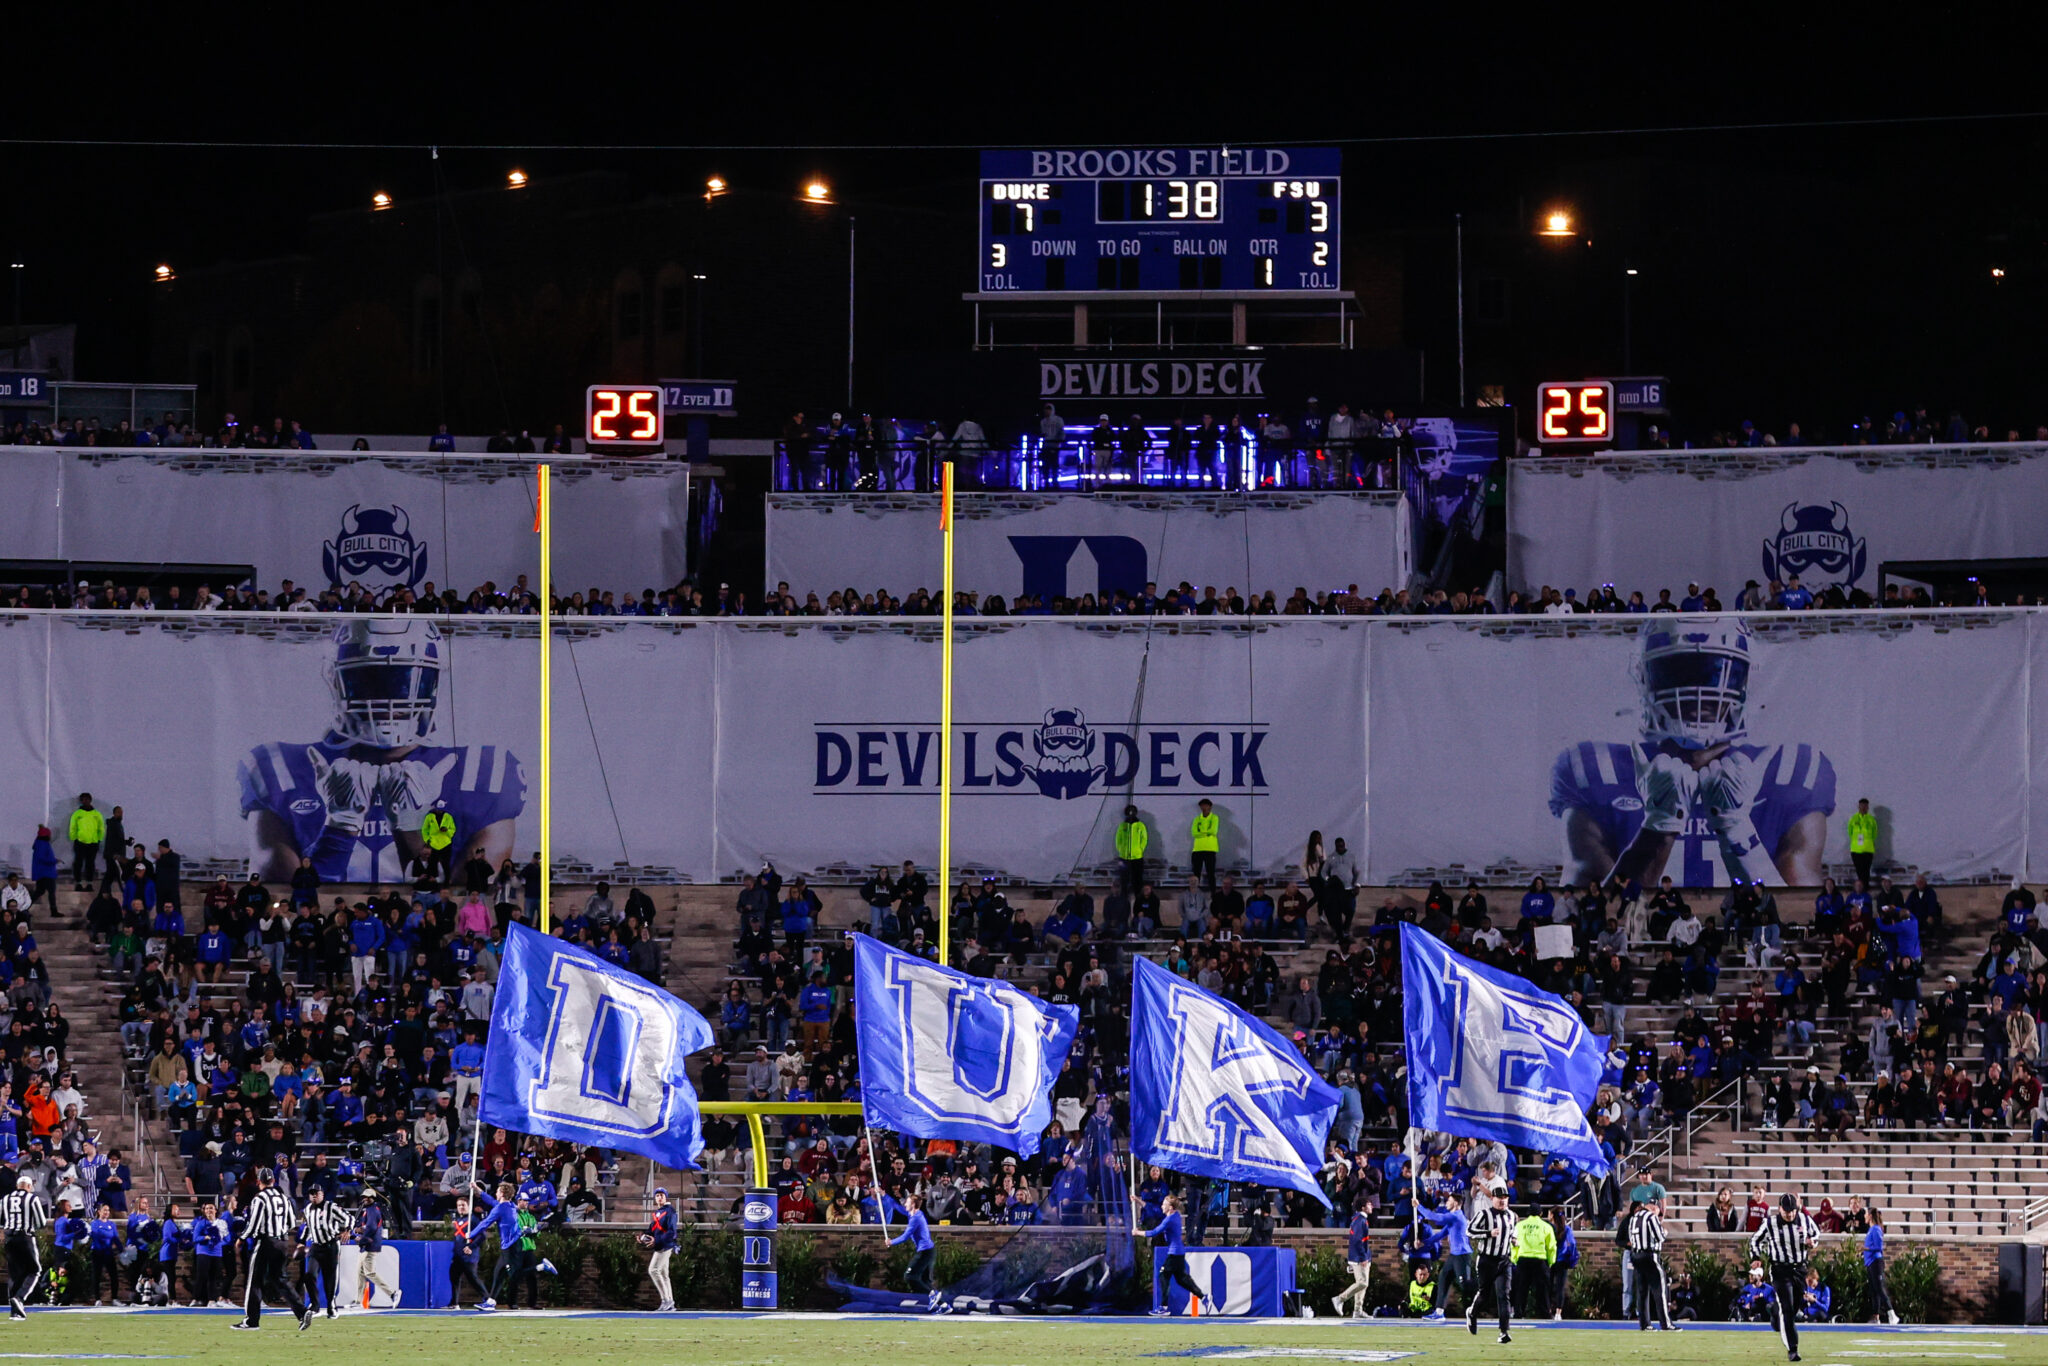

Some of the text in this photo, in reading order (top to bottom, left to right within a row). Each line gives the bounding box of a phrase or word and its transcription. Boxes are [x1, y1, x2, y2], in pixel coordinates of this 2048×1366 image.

[1031, 149, 1290, 177] BROOKS FIELD
[992, 183, 1050, 200] DUKE
[1144, 180, 1218, 219] 1:38
[1273, 181, 1321, 199] FSU
[1016, 203, 1033, 232] 7
[1310, 201, 1328, 232] 3
[991, 243, 1006, 268] 3
[1031, 240, 1077, 256] DOWN
[1098, 240, 1141, 256] TO GO
[1173, 240, 1228, 256] BALL ON
[1249, 239, 1279, 256] QTR
[1312, 241, 1328, 266] 2
[984, 274, 1020, 290] T.O.L.
[1265, 258, 1273, 286] 1
[1299, 272, 1335, 289] T.O.L.
[20, 377, 38, 396] 18
[1040, 362, 1265, 396] DEVILS DECK
[683, 394, 711, 406] EVEN
[1619, 385, 1660, 405] ODD 16
[593, 391, 656, 438] 25
[1545, 388, 1606, 436] 25
[343, 536, 407, 554] BULL CITY
[1783, 533, 1846, 552] BULL CITY
[1045, 727, 1083, 738] BULL CITY
[1101, 731, 1269, 787] DECK
[358, 820, 393, 837] UK
[529, 951, 678, 1139] D
[885, 953, 1059, 1134] U
[1438, 951, 1594, 1143] E
[1155, 982, 1316, 1185] K
[10, 1196, 22, 1213] R
[272, 1196, 284, 1215] C
[747, 1207, 767, 1215] ACC
[743, 1236, 771, 1265] D
[1182, 1252, 1252, 1315] D
